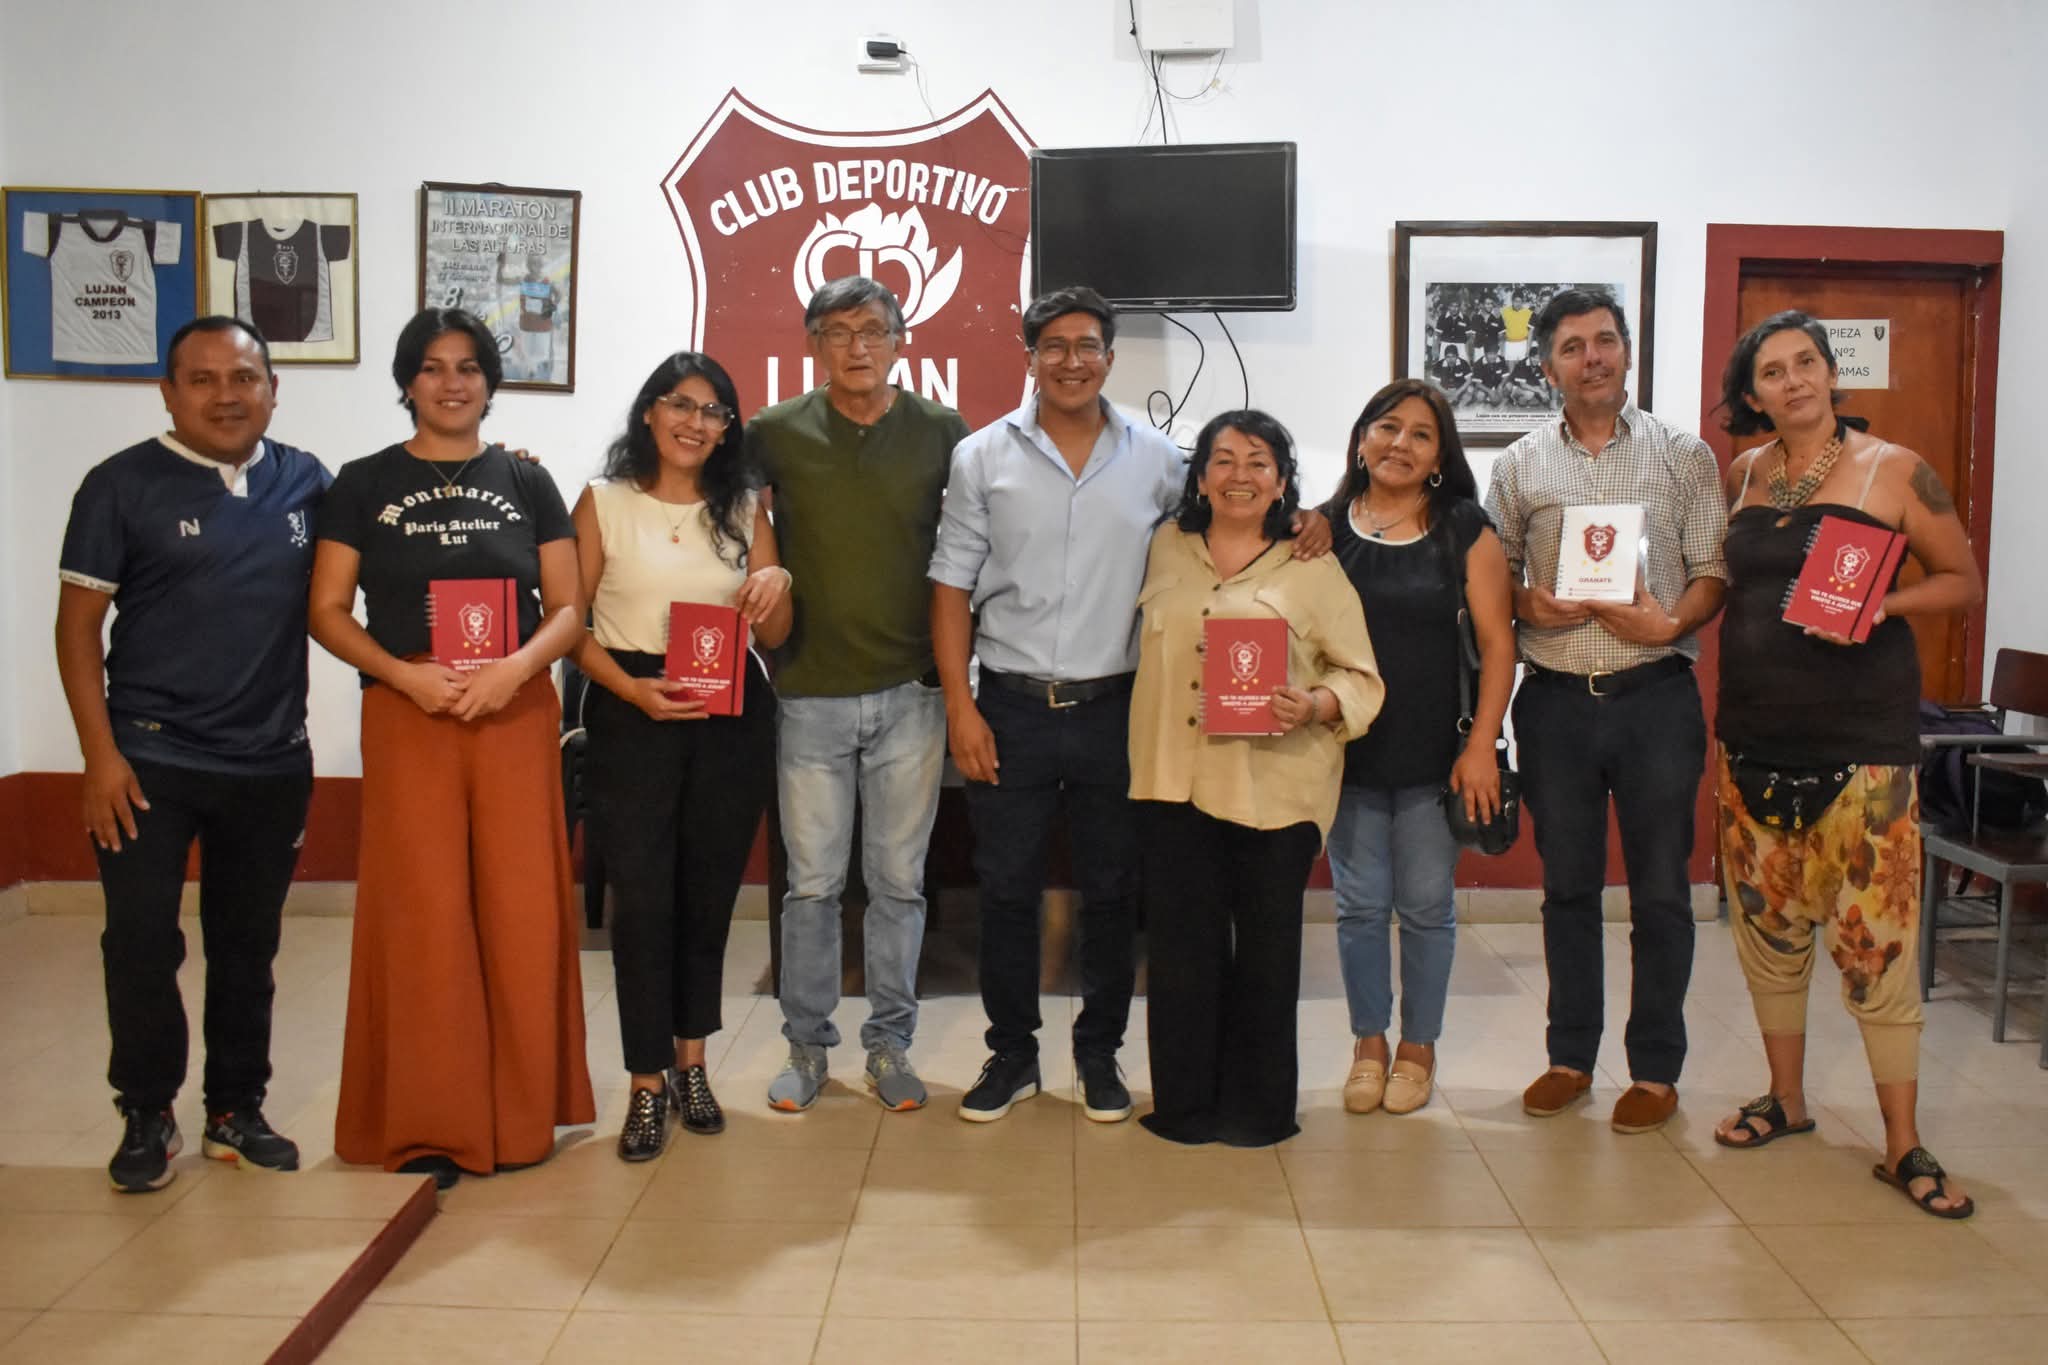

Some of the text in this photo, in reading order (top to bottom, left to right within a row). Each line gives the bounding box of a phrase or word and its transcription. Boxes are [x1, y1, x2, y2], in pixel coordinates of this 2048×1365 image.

[710, 159, 1008, 236] CLUB DEPORTIVO
[431, 219, 569, 239] INTERNACIONAL DE
[452, 239, 479, 253] LAS
[85, 284, 127, 295] LUJAN
[75, 297, 136, 307] CAMPEON
[92, 310, 122, 320] 2013
[1829, 328, 1861, 338] PIEZA
[1838, 367, 1870, 377] AMAS
[404, 519, 500, 536] Paris Atelier
